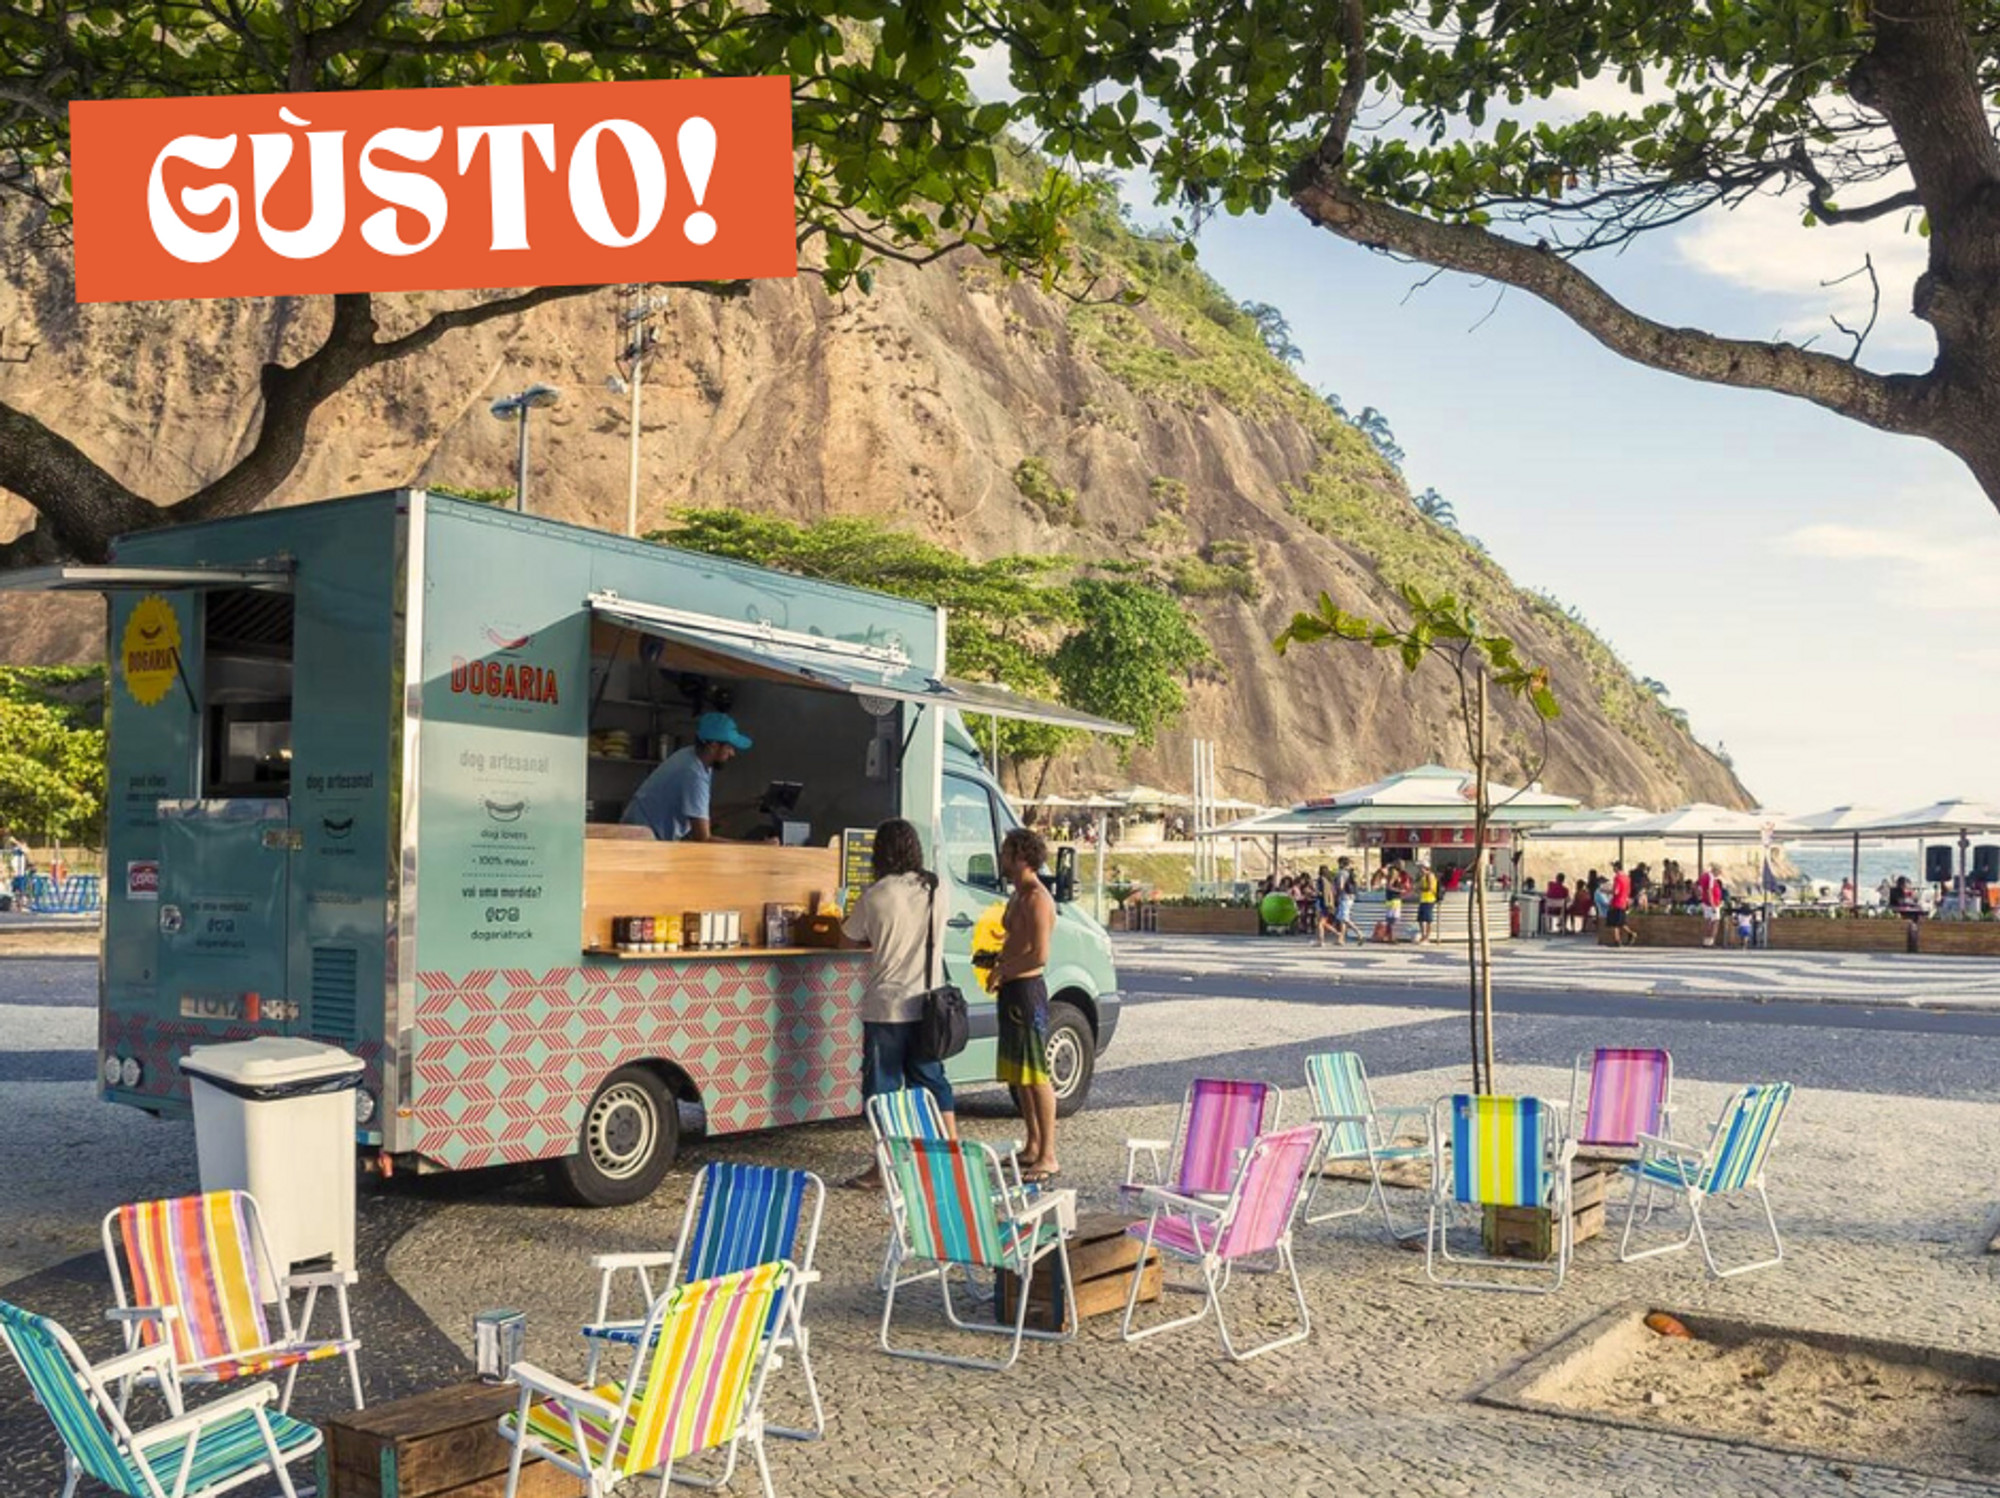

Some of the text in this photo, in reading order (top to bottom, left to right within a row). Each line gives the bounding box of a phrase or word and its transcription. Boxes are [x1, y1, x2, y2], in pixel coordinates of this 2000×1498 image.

[127, 649, 172, 674] DOGARIA
[451, 655, 559, 705] DOGARIA
[460, 752, 550, 775] dog artesanal
[306, 771, 374, 792] dog artesanal
[480, 830, 499, 840] dog
[479, 855, 503, 865] 100%
